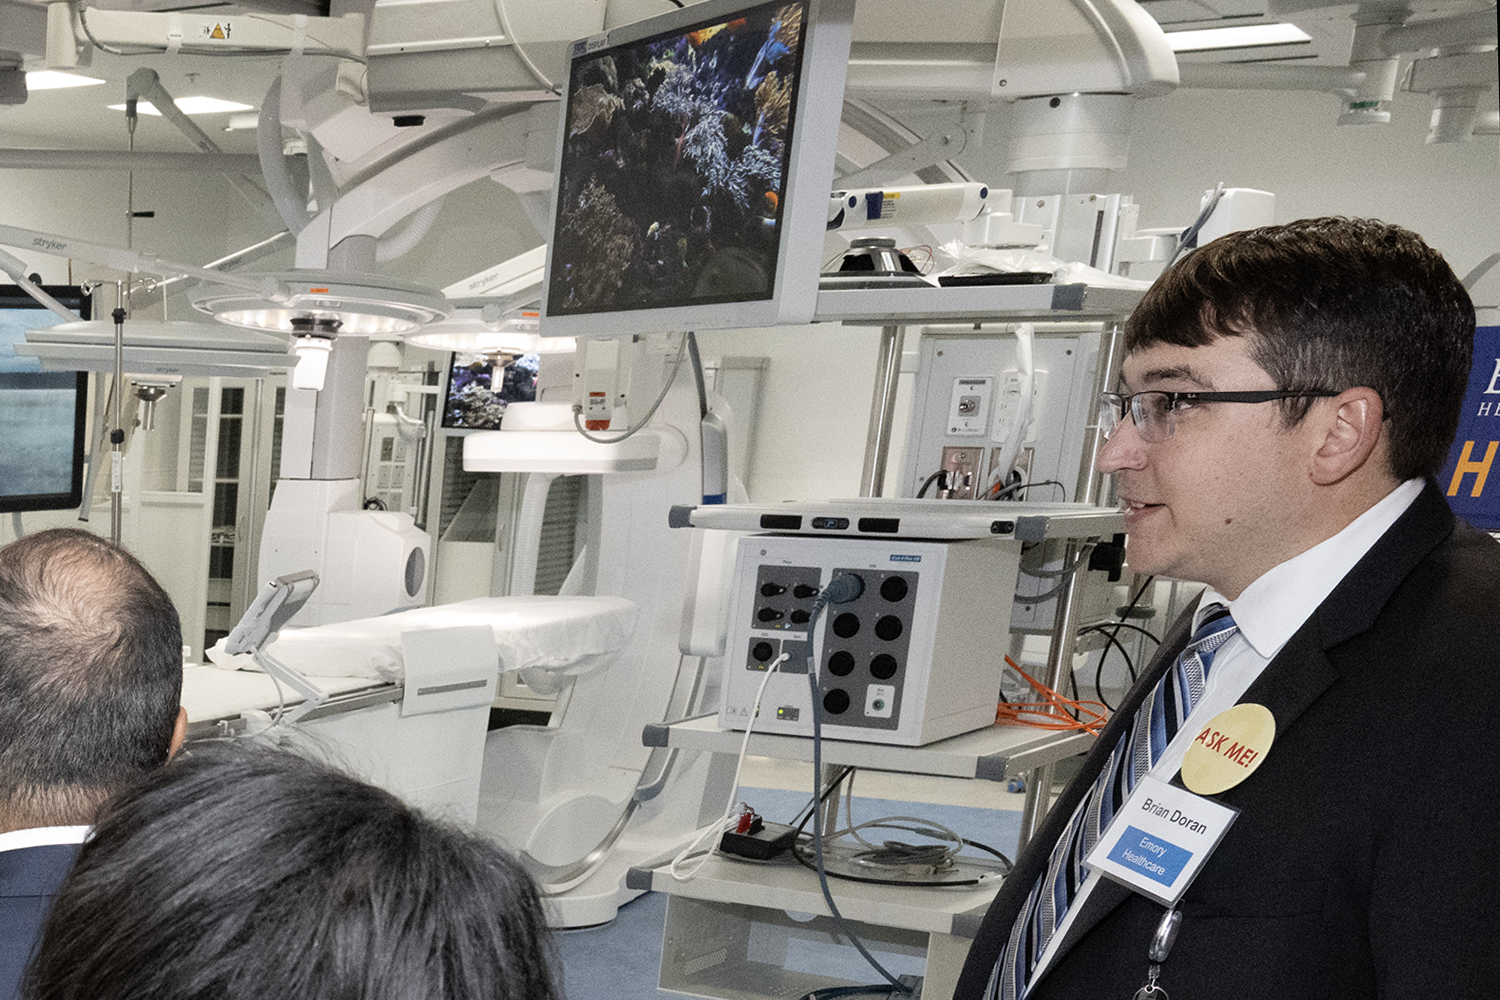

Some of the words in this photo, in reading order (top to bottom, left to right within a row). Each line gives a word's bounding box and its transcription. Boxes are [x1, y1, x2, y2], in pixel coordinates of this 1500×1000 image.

[32, 238, 67, 250] stryker
[1195, 727, 1229, 753] ASK
[1223, 742, 1258, 768] ME!
[1141, 798, 1171, 819] Brian
[1169, 810, 1207, 835] Doran
[1139, 837, 1167, 857] Emory
[1122, 849, 1165, 876] Healthcare
